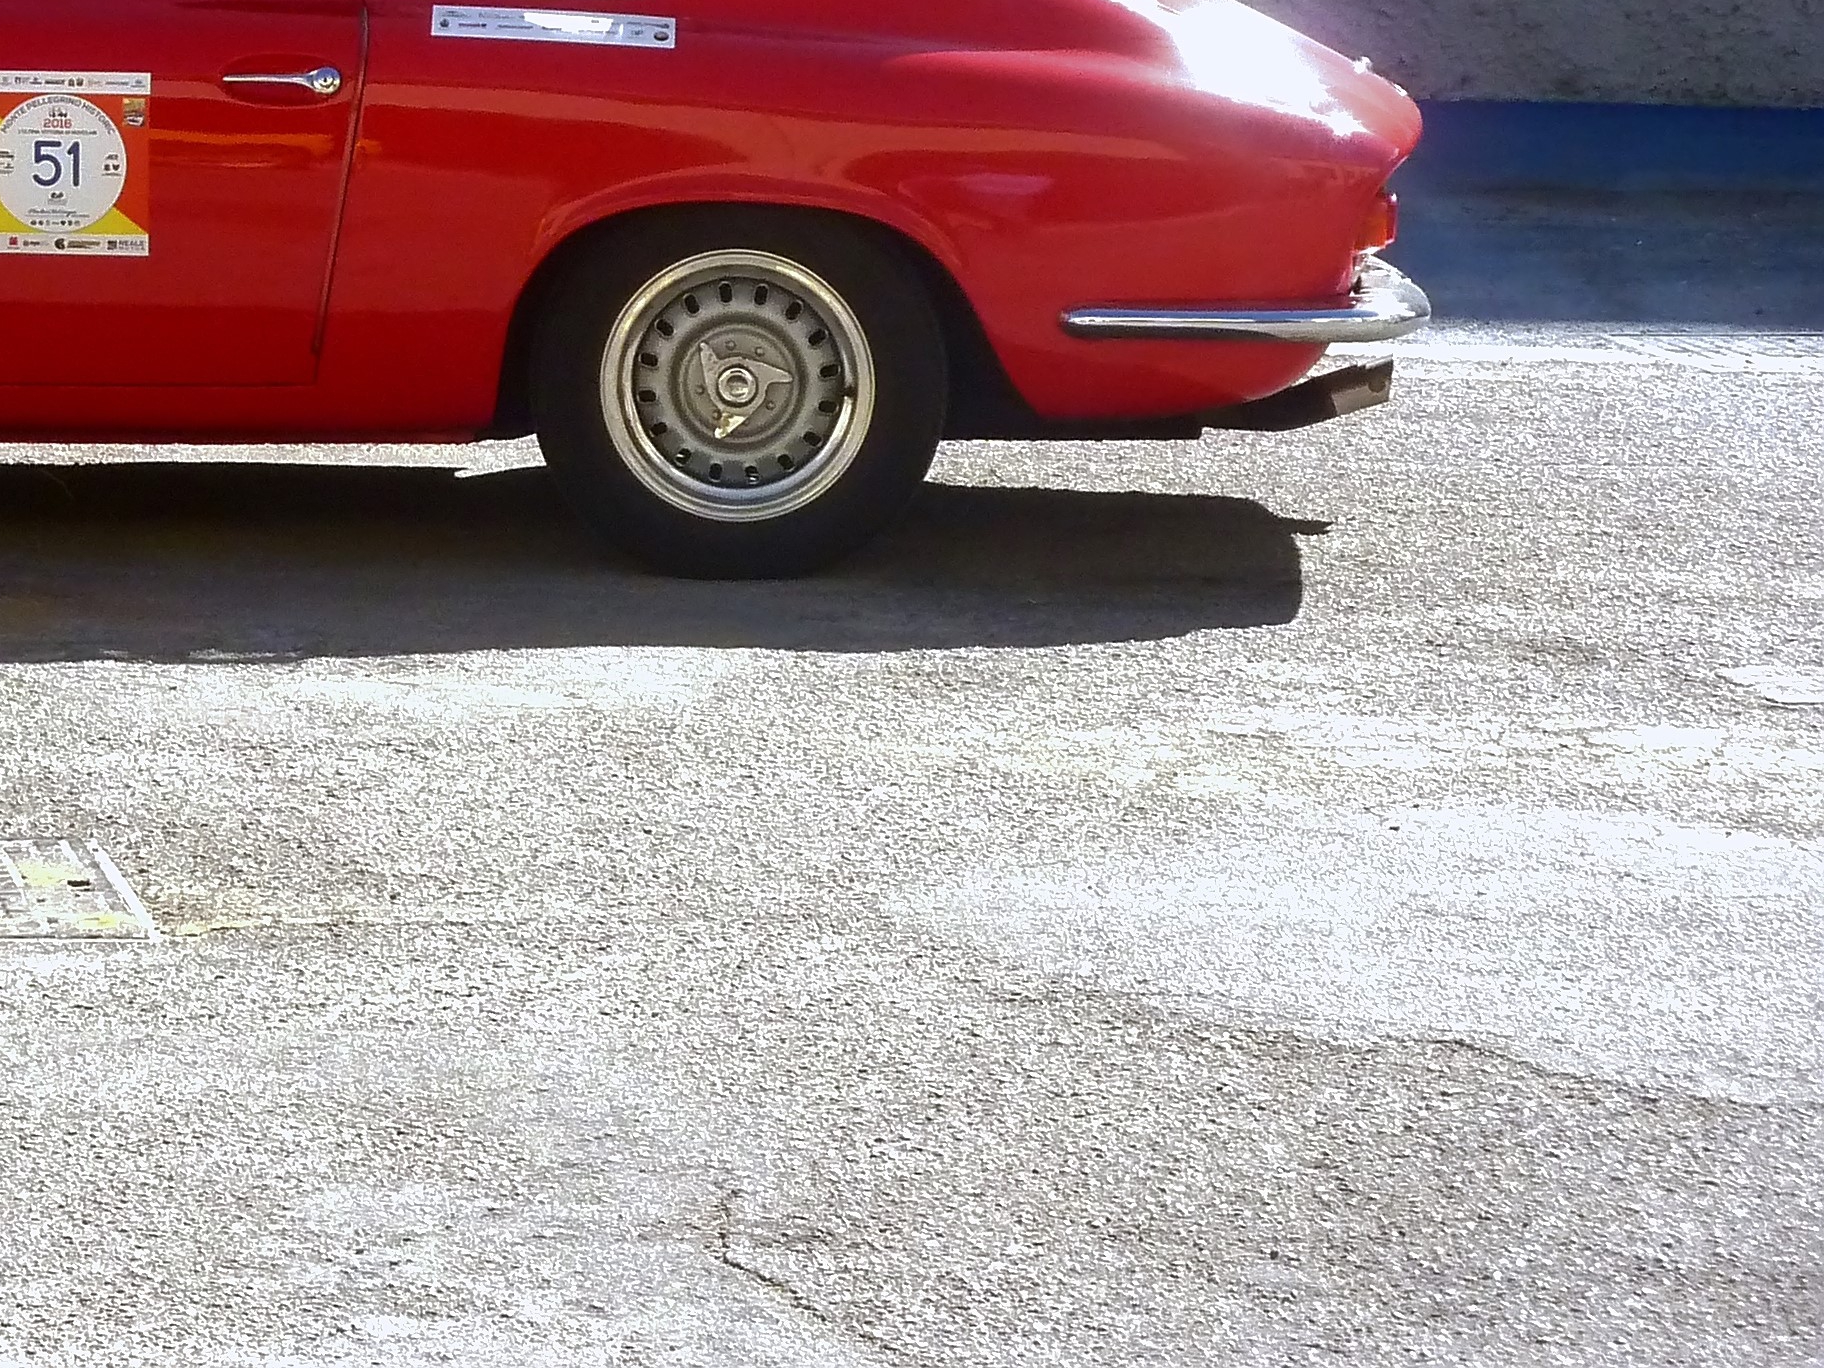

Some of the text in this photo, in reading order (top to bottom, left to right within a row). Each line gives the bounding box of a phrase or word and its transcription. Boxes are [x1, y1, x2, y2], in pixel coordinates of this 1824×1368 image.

[0, 96, 116, 135] MONTE PELLEGRINO HISTORIC
[32, 139, 81, 187] 51
